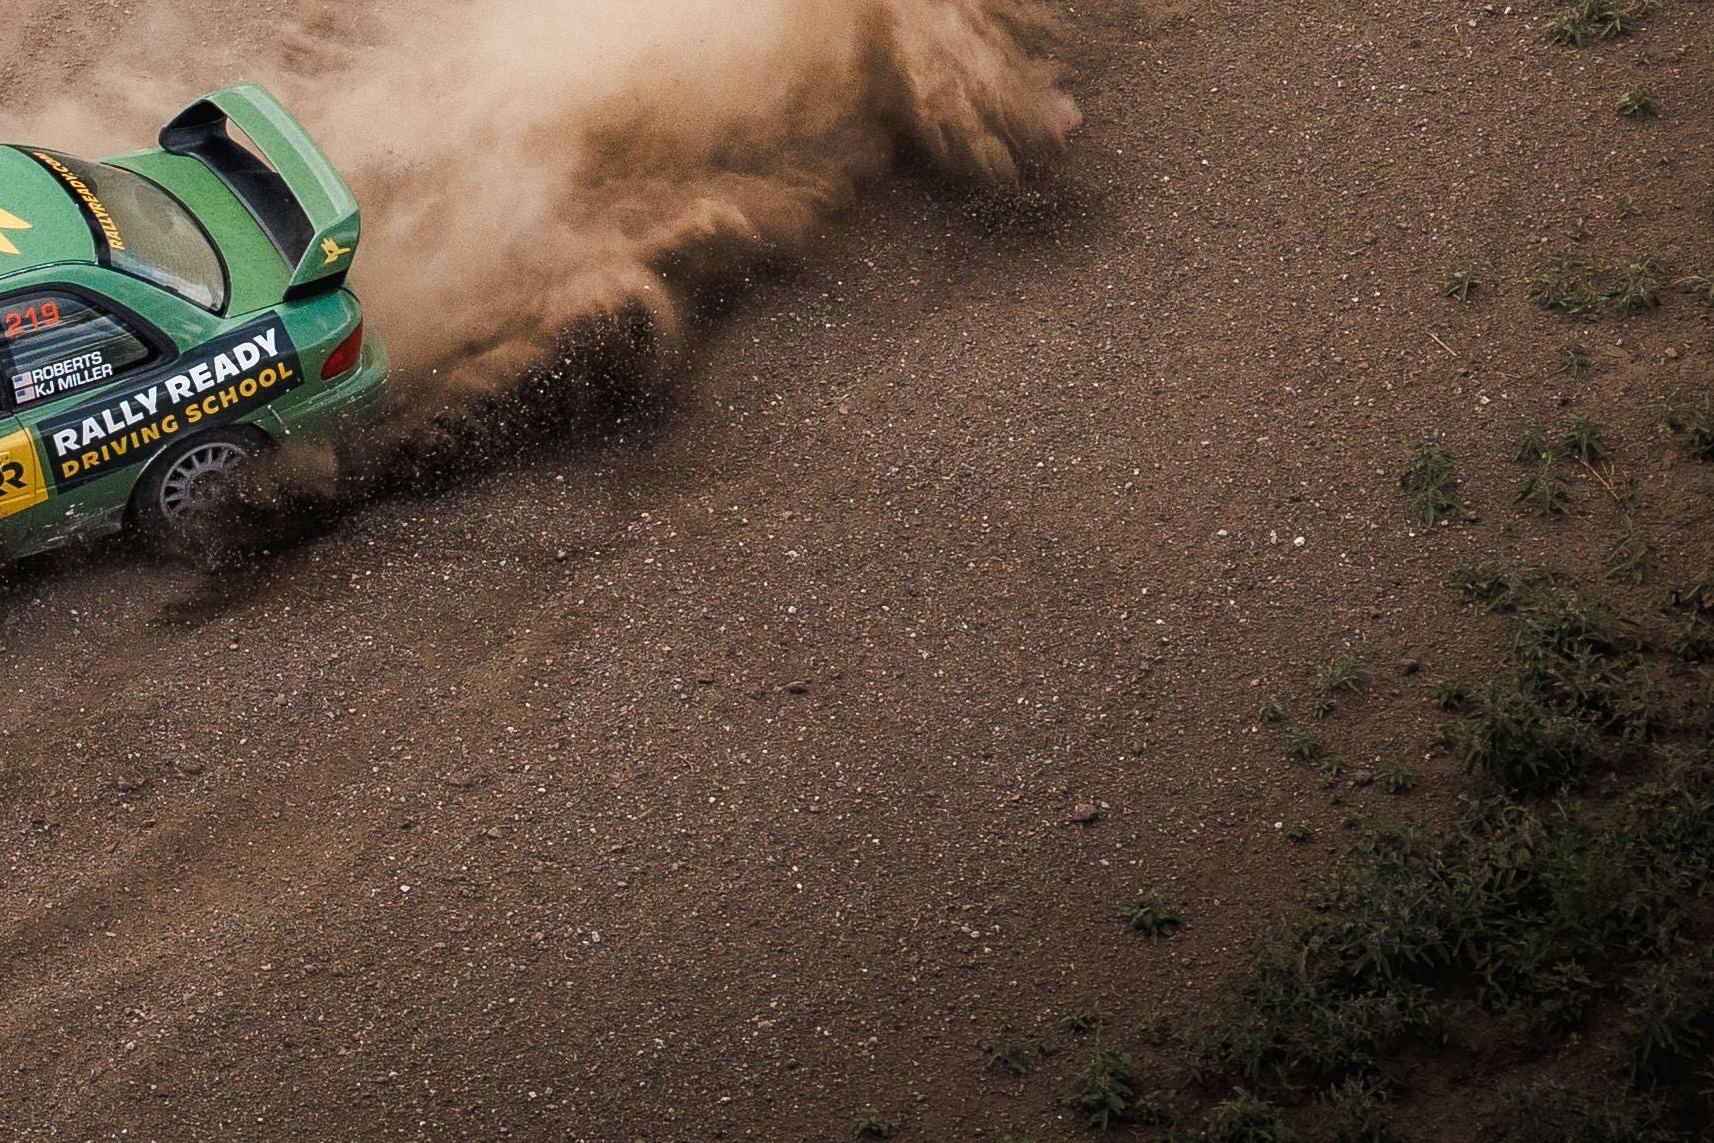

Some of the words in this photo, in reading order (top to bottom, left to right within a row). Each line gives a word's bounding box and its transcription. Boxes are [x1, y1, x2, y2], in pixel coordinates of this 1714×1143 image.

[3, 300, 60, 337] 219
[32, 351, 103, 384] ROBERTS
[34, 381, 55, 398] KJ
[57, 363, 113, 391] MILLER
[52, 386, 159, 457] RALLY
[164, 327, 281, 404] READY
[61, 414, 179, 478] DRIVING
[185, 361, 293, 424] SCHOOL
